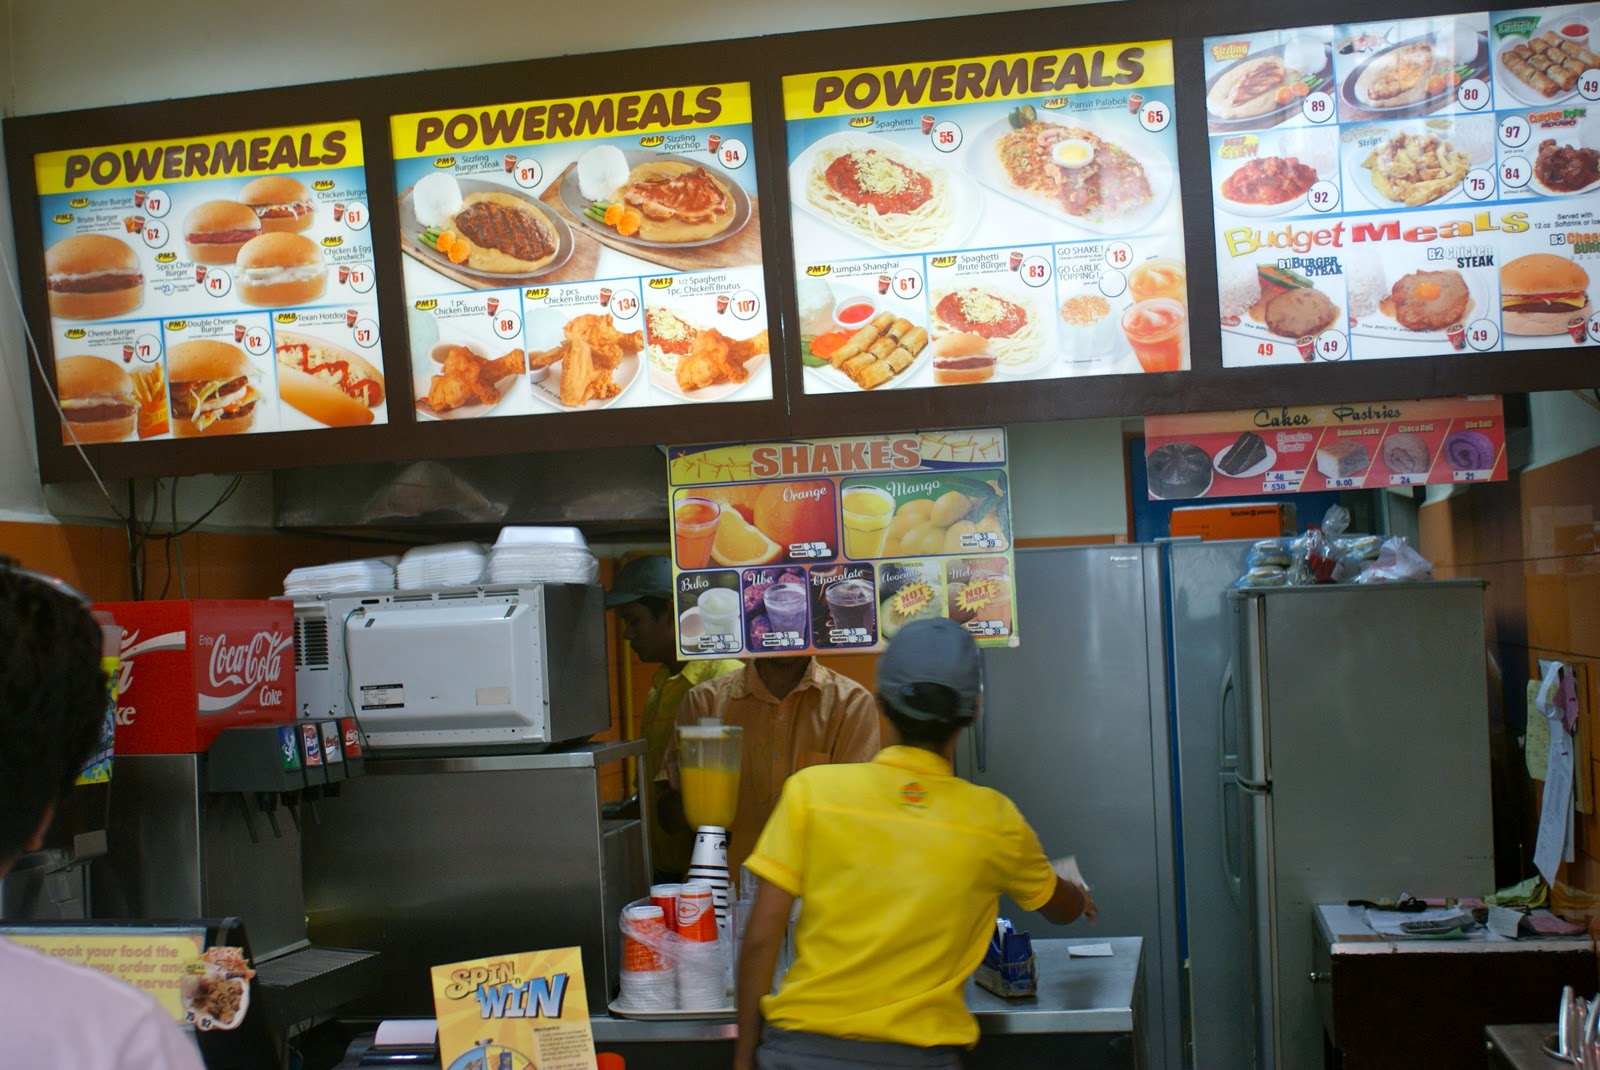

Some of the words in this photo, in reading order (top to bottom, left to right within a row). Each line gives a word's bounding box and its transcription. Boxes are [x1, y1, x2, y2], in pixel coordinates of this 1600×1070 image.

[813, 47, 1145, 113] POWERMEALS
[1583, 80, 1598, 93] 49
[1464, 88, 1479, 101] 80
[1043, 96, 1069, 106] PM15
[1069, 99, 1094, 109] Pansit
[1095, 97, 1128, 107] Palabok
[1311, 100, 1325, 112] 89
[415, 87, 722, 153] POWERMEALS
[850, 115, 875, 125] PM14
[875, 118, 914, 129] Spaghetti
[1147, 110, 1164, 123] 65
[939, 131, 954, 144] 55
[1505, 126, 1520, 138] 97
[640, 135, 665, 145] PM10
[666, 134, 696, 143] Sizzling
[1358, 136, 1382, 148] Strips
[664, 141, 701, 151] Porkchop
[64, 130, 347, 189] POWERMEALS
[436, 156, 455, 165] PM9
[461, 154, 489, 164] Sizzling
[725, 150, 740, 162] 94
[455, 163, 478, 172] Burger
[479, 160, 500, 170] Steak
[521, 167, 535, 181] 87
[1505, 168, 1520, 180] 84
[314, 180, 334, 188] PM4
[1470, 179, 1485, 191] 75
[317, 190, 345, 200] Chicken
[1314, 191, 1328, 203] 92
[109, 198, 132, 206] Burger
[149, 199, 161, 211] 47
[77, 216, 95, 224] Brute
[96, 214, 118, 223] Burger
[348, 210, 361, 223] 61
[1554, 220, 1581, 228] Softdrink
[147, 228, 159, 240] 62
[324, 236, 343, 244] PM5
[1224, 221, 1345, 257] Budget
[1550, 233, 1565, 246] B3
[1566, 232, 1600, 244] Chee
[324, 246, 351, 256] Chicken
[358, 245, 372, 255] Egg
[1057, 247, 1071, 256] GO
[1072, 246, 1099, 254] SHAKE
[1112, 249, 1127, 263] 13
[1427, 247, 1443, 260] B2
[332, 252, 365, 262] Sandwich
[932, 255, 957, 265] PM17
[960, 252, 999, 264] Spaghetti
[1277, 258, 1291, 270] B1
[1291, 256, 1338, 269] BURGER
[1457, 255, 1494, 268] STEAK
[156, 263, 175, 272] Spicy
[807, 264, 831, 274] PM16
[832, 264, 861, 275] Lumpia
[862, 261, 899, 272] Shanghai
[957, 263, 979, 271] Brute
[980, 261, 1007, 270] Burger
[1029, 265, 1045, 278] 83
[1057, 265, 1071, 274] GO
[1072, 263, 1101, 273] GARLIC
[1305, 264, 1343, 277] STEAK
[165, 270, 188, 278] Burger
[351, 272, 365, 283] 61
[649, 277, 673, 286] PM13
[689, 274, 727, 285] Spaghetti
[1058, 272, 1095, 281] TOPPING
[683, 286, 714, 294] Chicken
[715, 282, 741, 291] Brutus
[900, 277, 915, 291] 67
[526, 288, 549, 297] PM12
[415, 299, 438, 308] PM11
[543, 296, 573, 305] Chicken
[574, 294, 599, 302] Brutus
[617, 298, 637, 312] 134
[433, 306, 462, 316] Chicken
[463, 305, 486, 313] Brutus
[737, 300, 755, 313] 107
[168, 320, 187, 328] PM7
[187, 318, 213, 328] Double
[213, 317, 238, 326] Cheese
[277, 313, 297, 323] PM8
[298, 313, 317, 321] Texan
[319, 311, 346, 321] Hotdog
[200, 325, 224, 334] Burger
[500, 319, 513, 332] 88
[87, 330, 111, 338] Cheese
[112, 328, 136, 338] Burger
[357, 330, 371, 342] 57
[1472, 329, 1487, 342] 49
[249, 337, 262, 348] 82
[1323, 340, 1338, 353] 49
[1257, 343, 1274, 356] 49
[1253, 406, 1311, 428] Cakes
[1332, 405, 1402, 423] Pastries
[1398, 425, 1419, 433] Choco
[1420, 424, 1434, 432] Roll
[1479, 420, 1493, 428] Roll
[1337, 429, 1362, 437] Banana
[1363, 427, 1380, 435] Cake
[752, 438, 922, 477] SHAKES
[1400, 476, 1411, 484] 24
[1465, 472, 1474, 480] 21
[886, 480, 941, 497] Mango
[1335, 478, 1353, 487] 9.00
[783, 487, 827, 502] Orange
[987, 540, 996, 548] 39
[814, 549, 822, 557] 39
[747, 571, 774, 586] Ube
[811, 567, 864, 587] Chocolate
[881, 569, 920, 583] Avocado
[681, 575, 709, 592] Buko
[900, 586, 924, 603] NOT
[965, 584, 990, 598] NOT
[992, 627, 1001, 635] 39
[199, 634, 215, 646] Enjoy
[786, 639, 796, 647] 39
[855, 635, 864, 643] 39
[722, 642, 731, 650] 39
[259, 684, 283, 707] Coke
[50, 944, 83, 957] cook
[85, 946, 118, 961] your
[120, 944, 153, 957] food
[156, 944, 178, 958] the
[118, 960, 158, 974] order
[135, 977, 184, 989] served
[445, 961, 515, 1000] SPIN
[475, 972, 570, 1020] WIN
